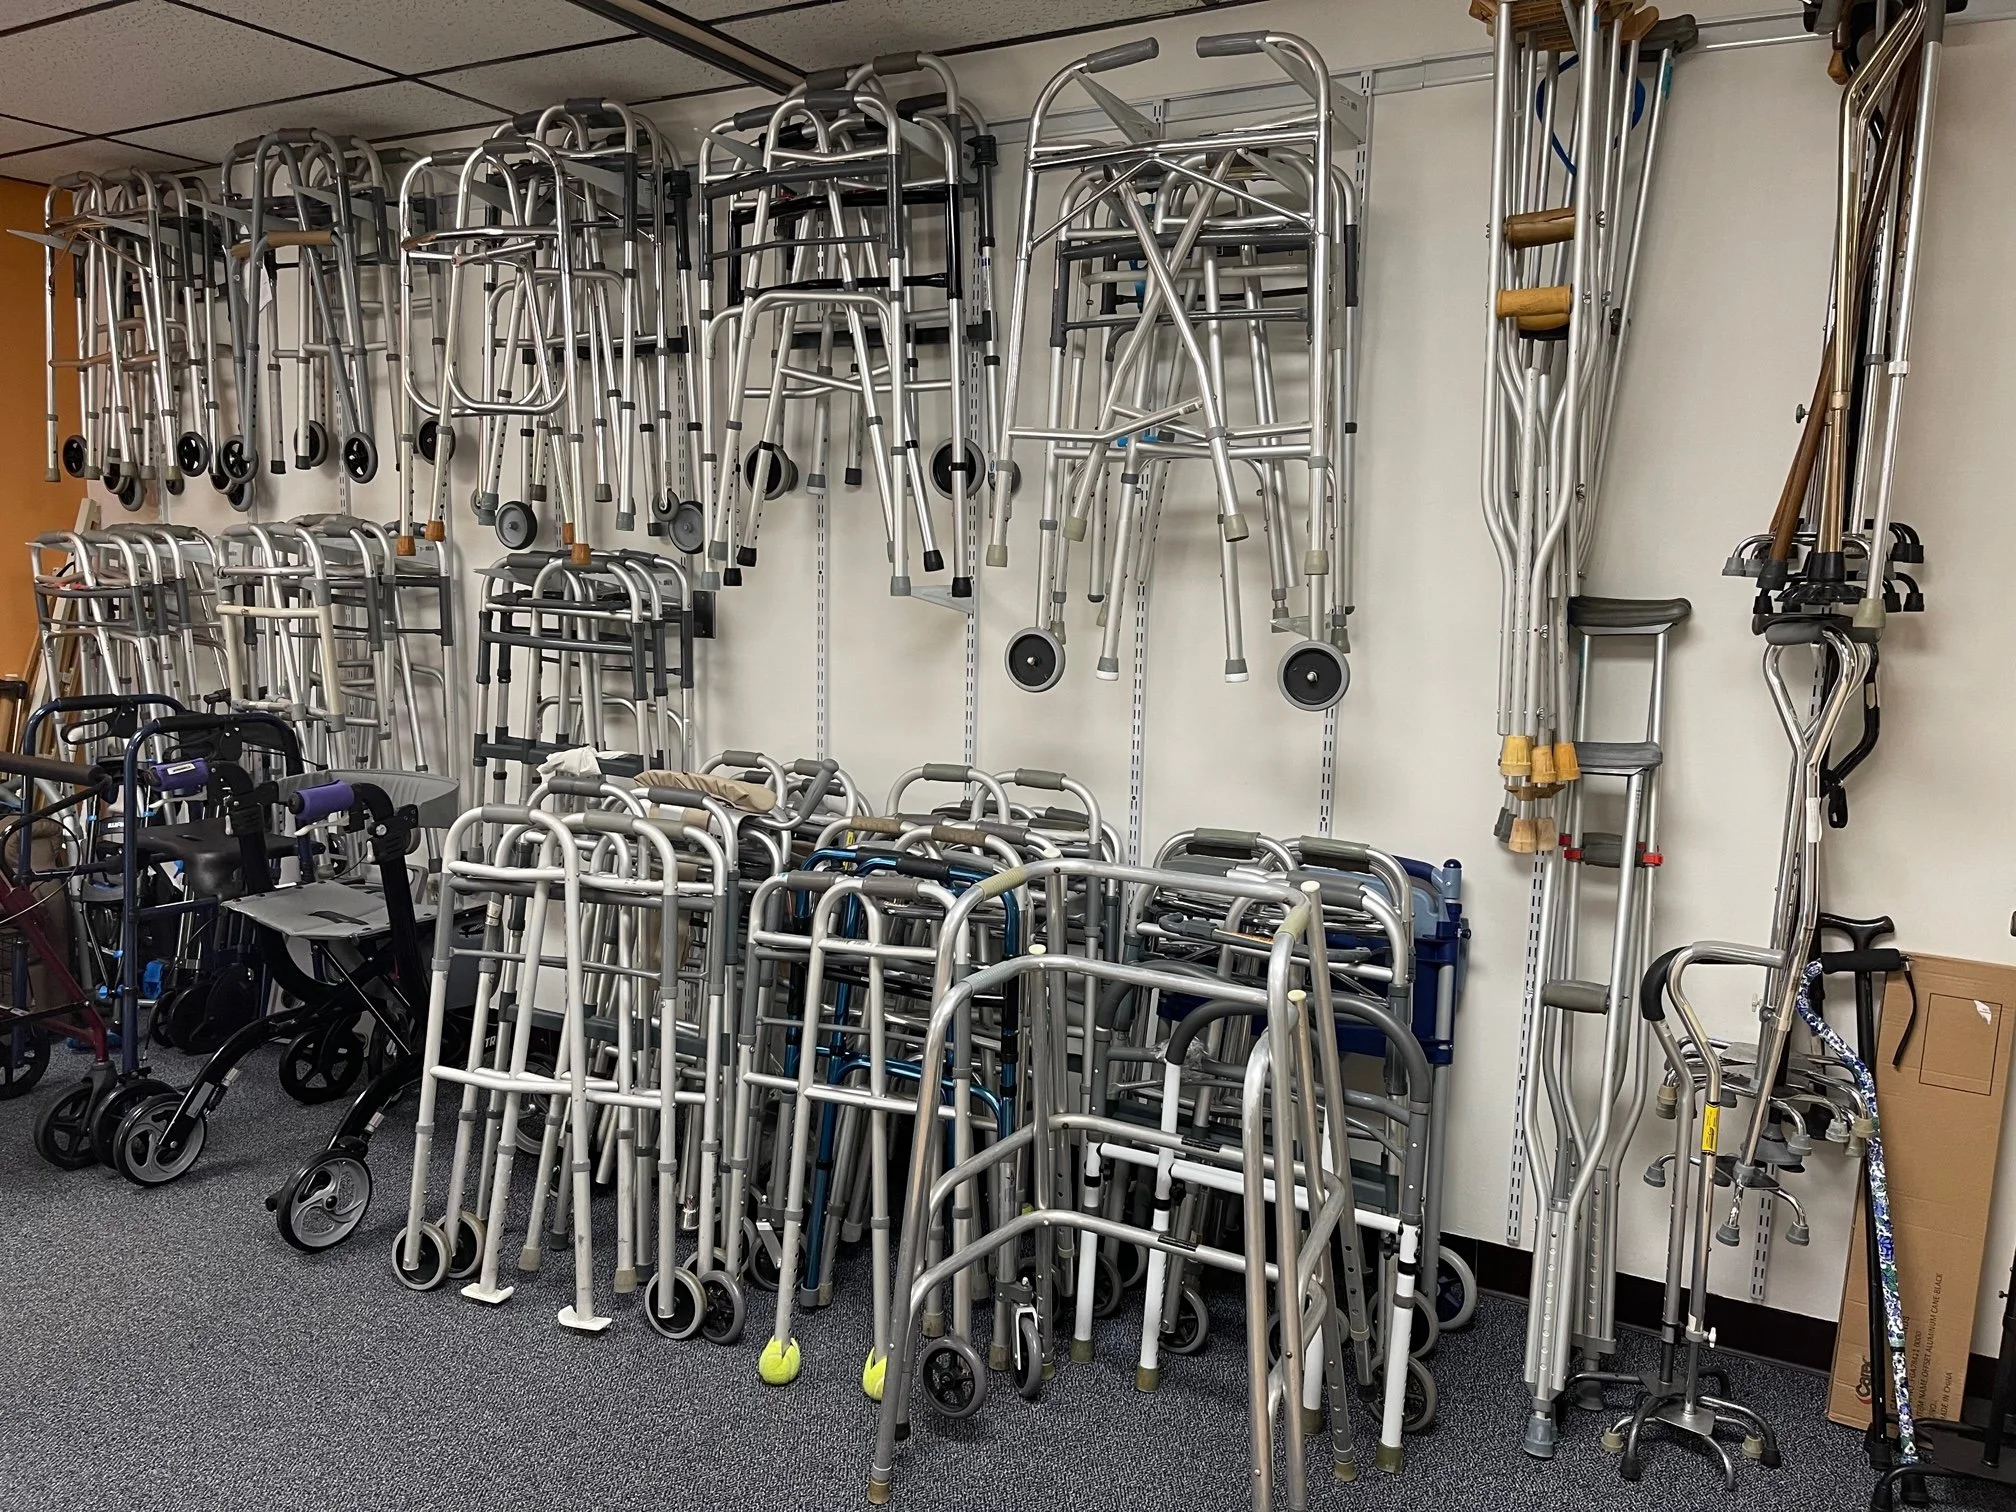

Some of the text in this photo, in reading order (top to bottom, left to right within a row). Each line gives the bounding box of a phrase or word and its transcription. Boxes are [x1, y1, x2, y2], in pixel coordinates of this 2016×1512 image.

[1926, 1314, 1937, 1353] ALUMINUM
[1944, 1372, 1953, 1394] CHINA
[1943, 1394, 1950, 1403] IN
